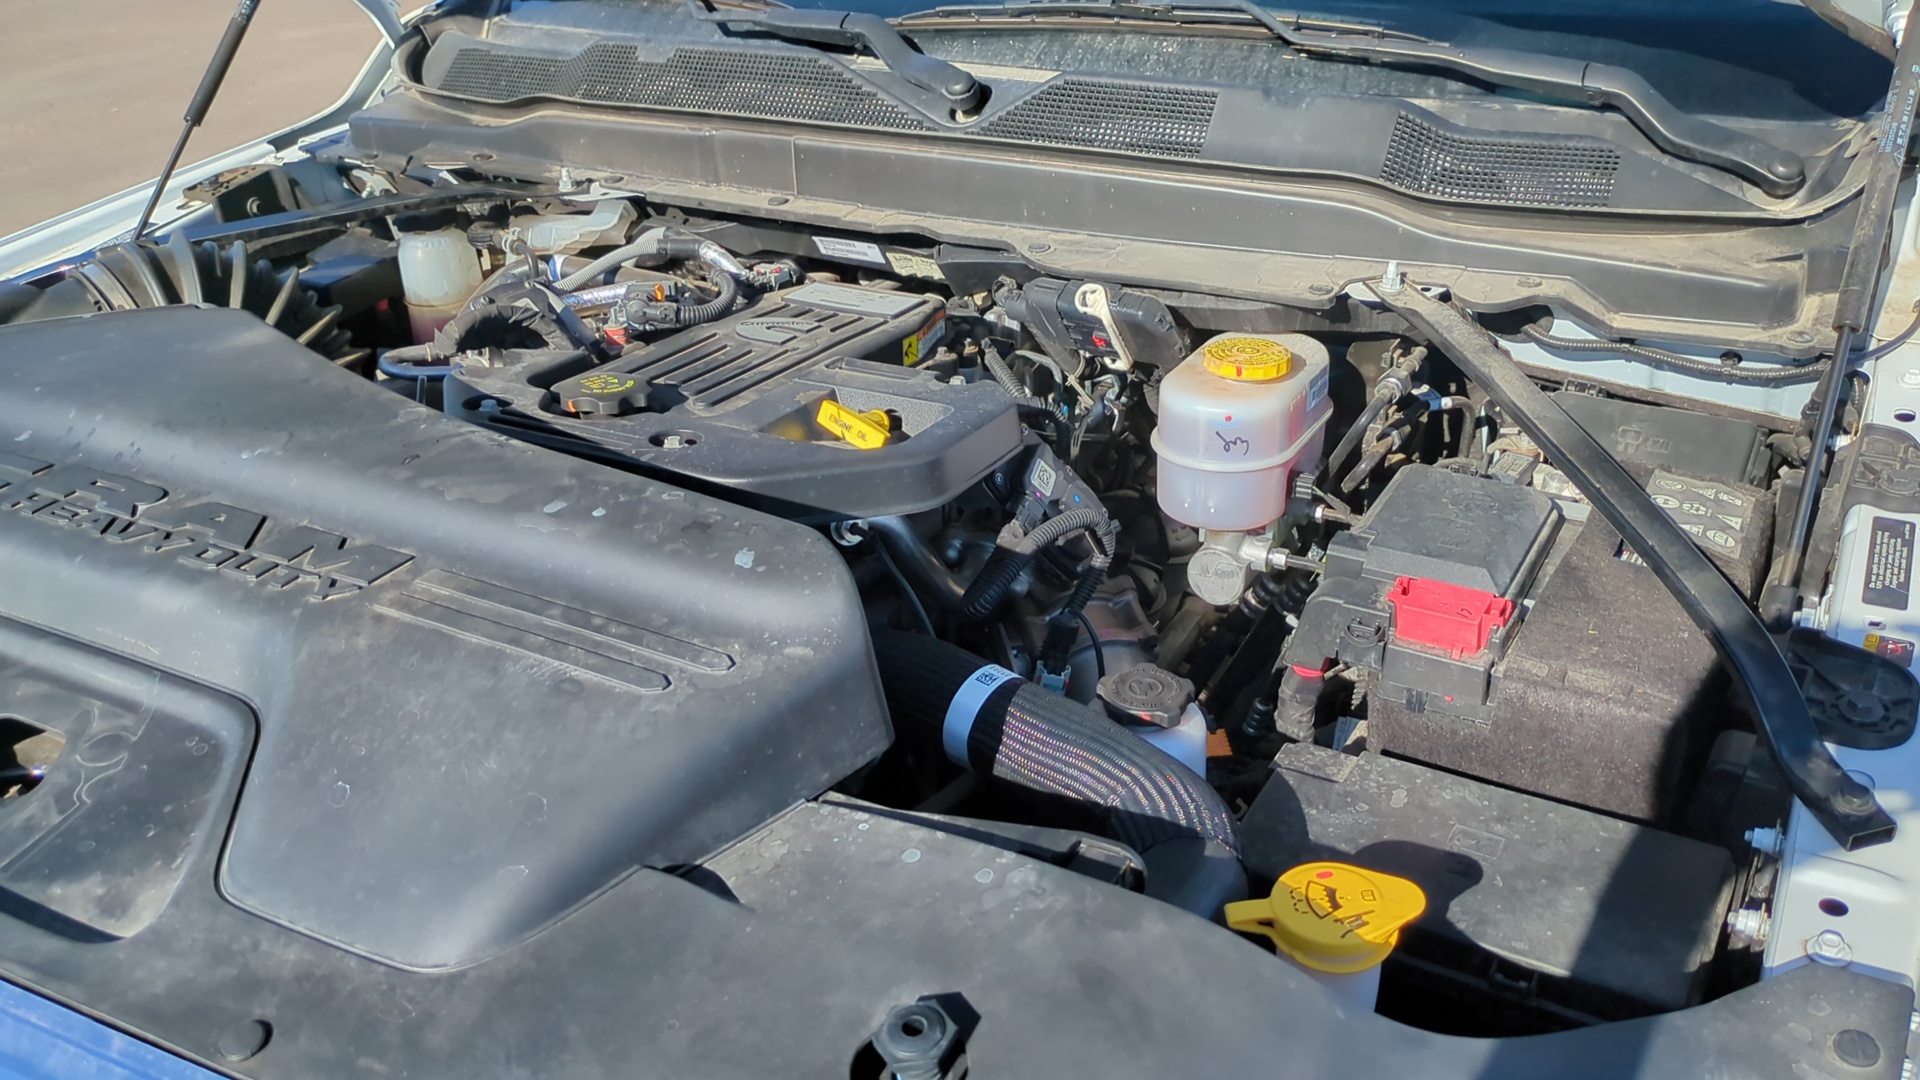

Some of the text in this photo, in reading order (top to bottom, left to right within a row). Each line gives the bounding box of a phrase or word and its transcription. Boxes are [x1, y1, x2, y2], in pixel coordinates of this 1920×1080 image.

[1897, 89, 1916, 146] STABILUS
[828, 412, 868, 443] ENGINE OIL
[1, 488, 363, 600] HEAVY DUTY
[33, 465, 416, 587] RAM
